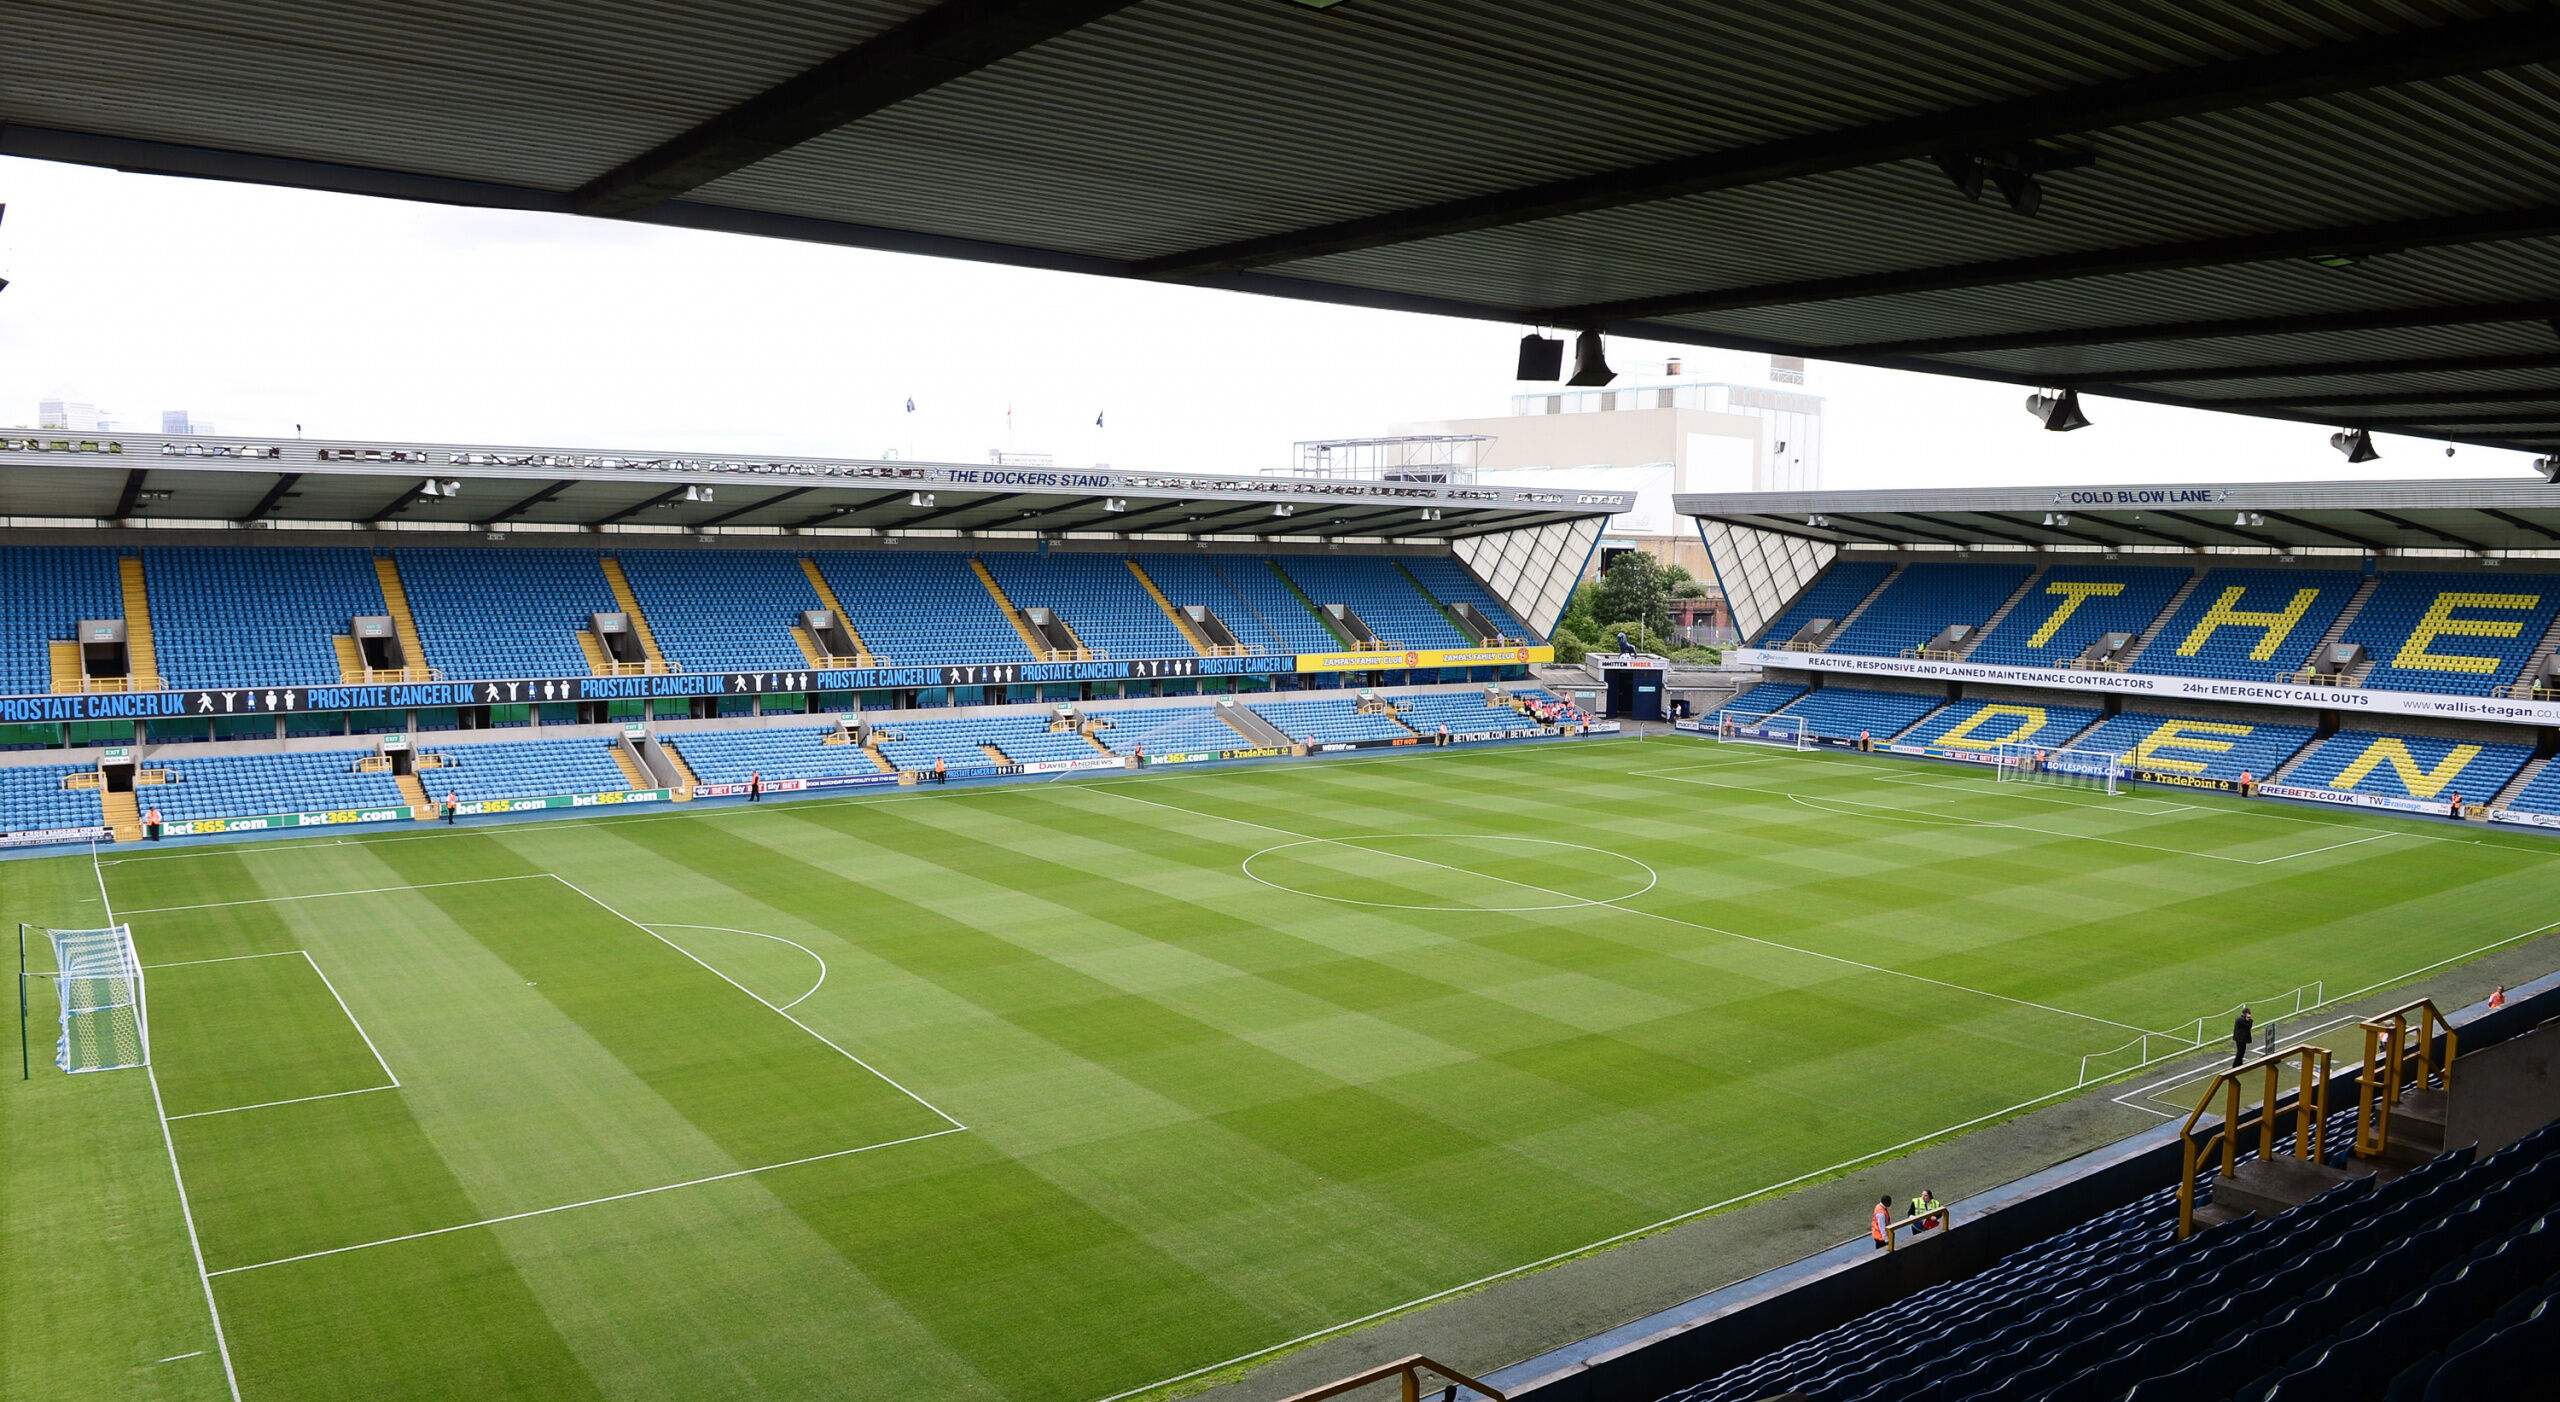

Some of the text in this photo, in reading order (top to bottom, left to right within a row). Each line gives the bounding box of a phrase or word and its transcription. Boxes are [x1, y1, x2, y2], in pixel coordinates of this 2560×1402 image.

[948, 469, 1109, 487] THE DOCKERS STAND
[2071, 490, 2213, 504] COLD BLOW LANE
[1198, 656, 1294, 674] PROSTATE CANCER UK
[1323, 656, 1403, 667] ZAMPA'S FAMILY CLUB
[1443, 652, 1515, 662] ZAMPA'S FAMILY CLUB
[817, 668, 942, 689] PROSTATE CANCER UK
[1021, 662, 1130, 681] PROSTATE CANCER UK
[1808, 657, 2154, 690] REACTIVE, RESPONSIVE AND PLANNED MAINTENANCE CONTRACTORS
[580, 675, 725, 698] PROSTATE CANCER UK
[2183, 683, 2369, 705] 24hr EMERGENCY CALL OUTS
[307, 684, 474, 709] PROSTATE CANCER UK
[88, 695, 158, 717] CANCER
[161, 693, 185, 714] UK
[1453, 730, 1505, 743] BETVICTOR.COM
[1511, 727, 1560, 739] BETVICTOR.COM
[1151, 754, 1208, 765] bet365.com
[1233, 748, 1278, 759] TradePoint
[1039, 761, 1067, 770] DAVID
[1070, 758, 1113, 768] ANDREWS
[946, 767, 997, 779] PROSTATE CANCER UK
[2155, 772, 2217, 790] TradePoint
[712, 786, 728, 794] BET
[782, 781, 798, 789] BET
[573, 792, 657, 806] bet365.com
[2260, 785, 2354, 803] FREEBETS.CO.UK
[456, 799, 546, 815] bet365.com
[299, 809, 397, 825] bet365.com
[163, 818, 268, 835] bet365.com
